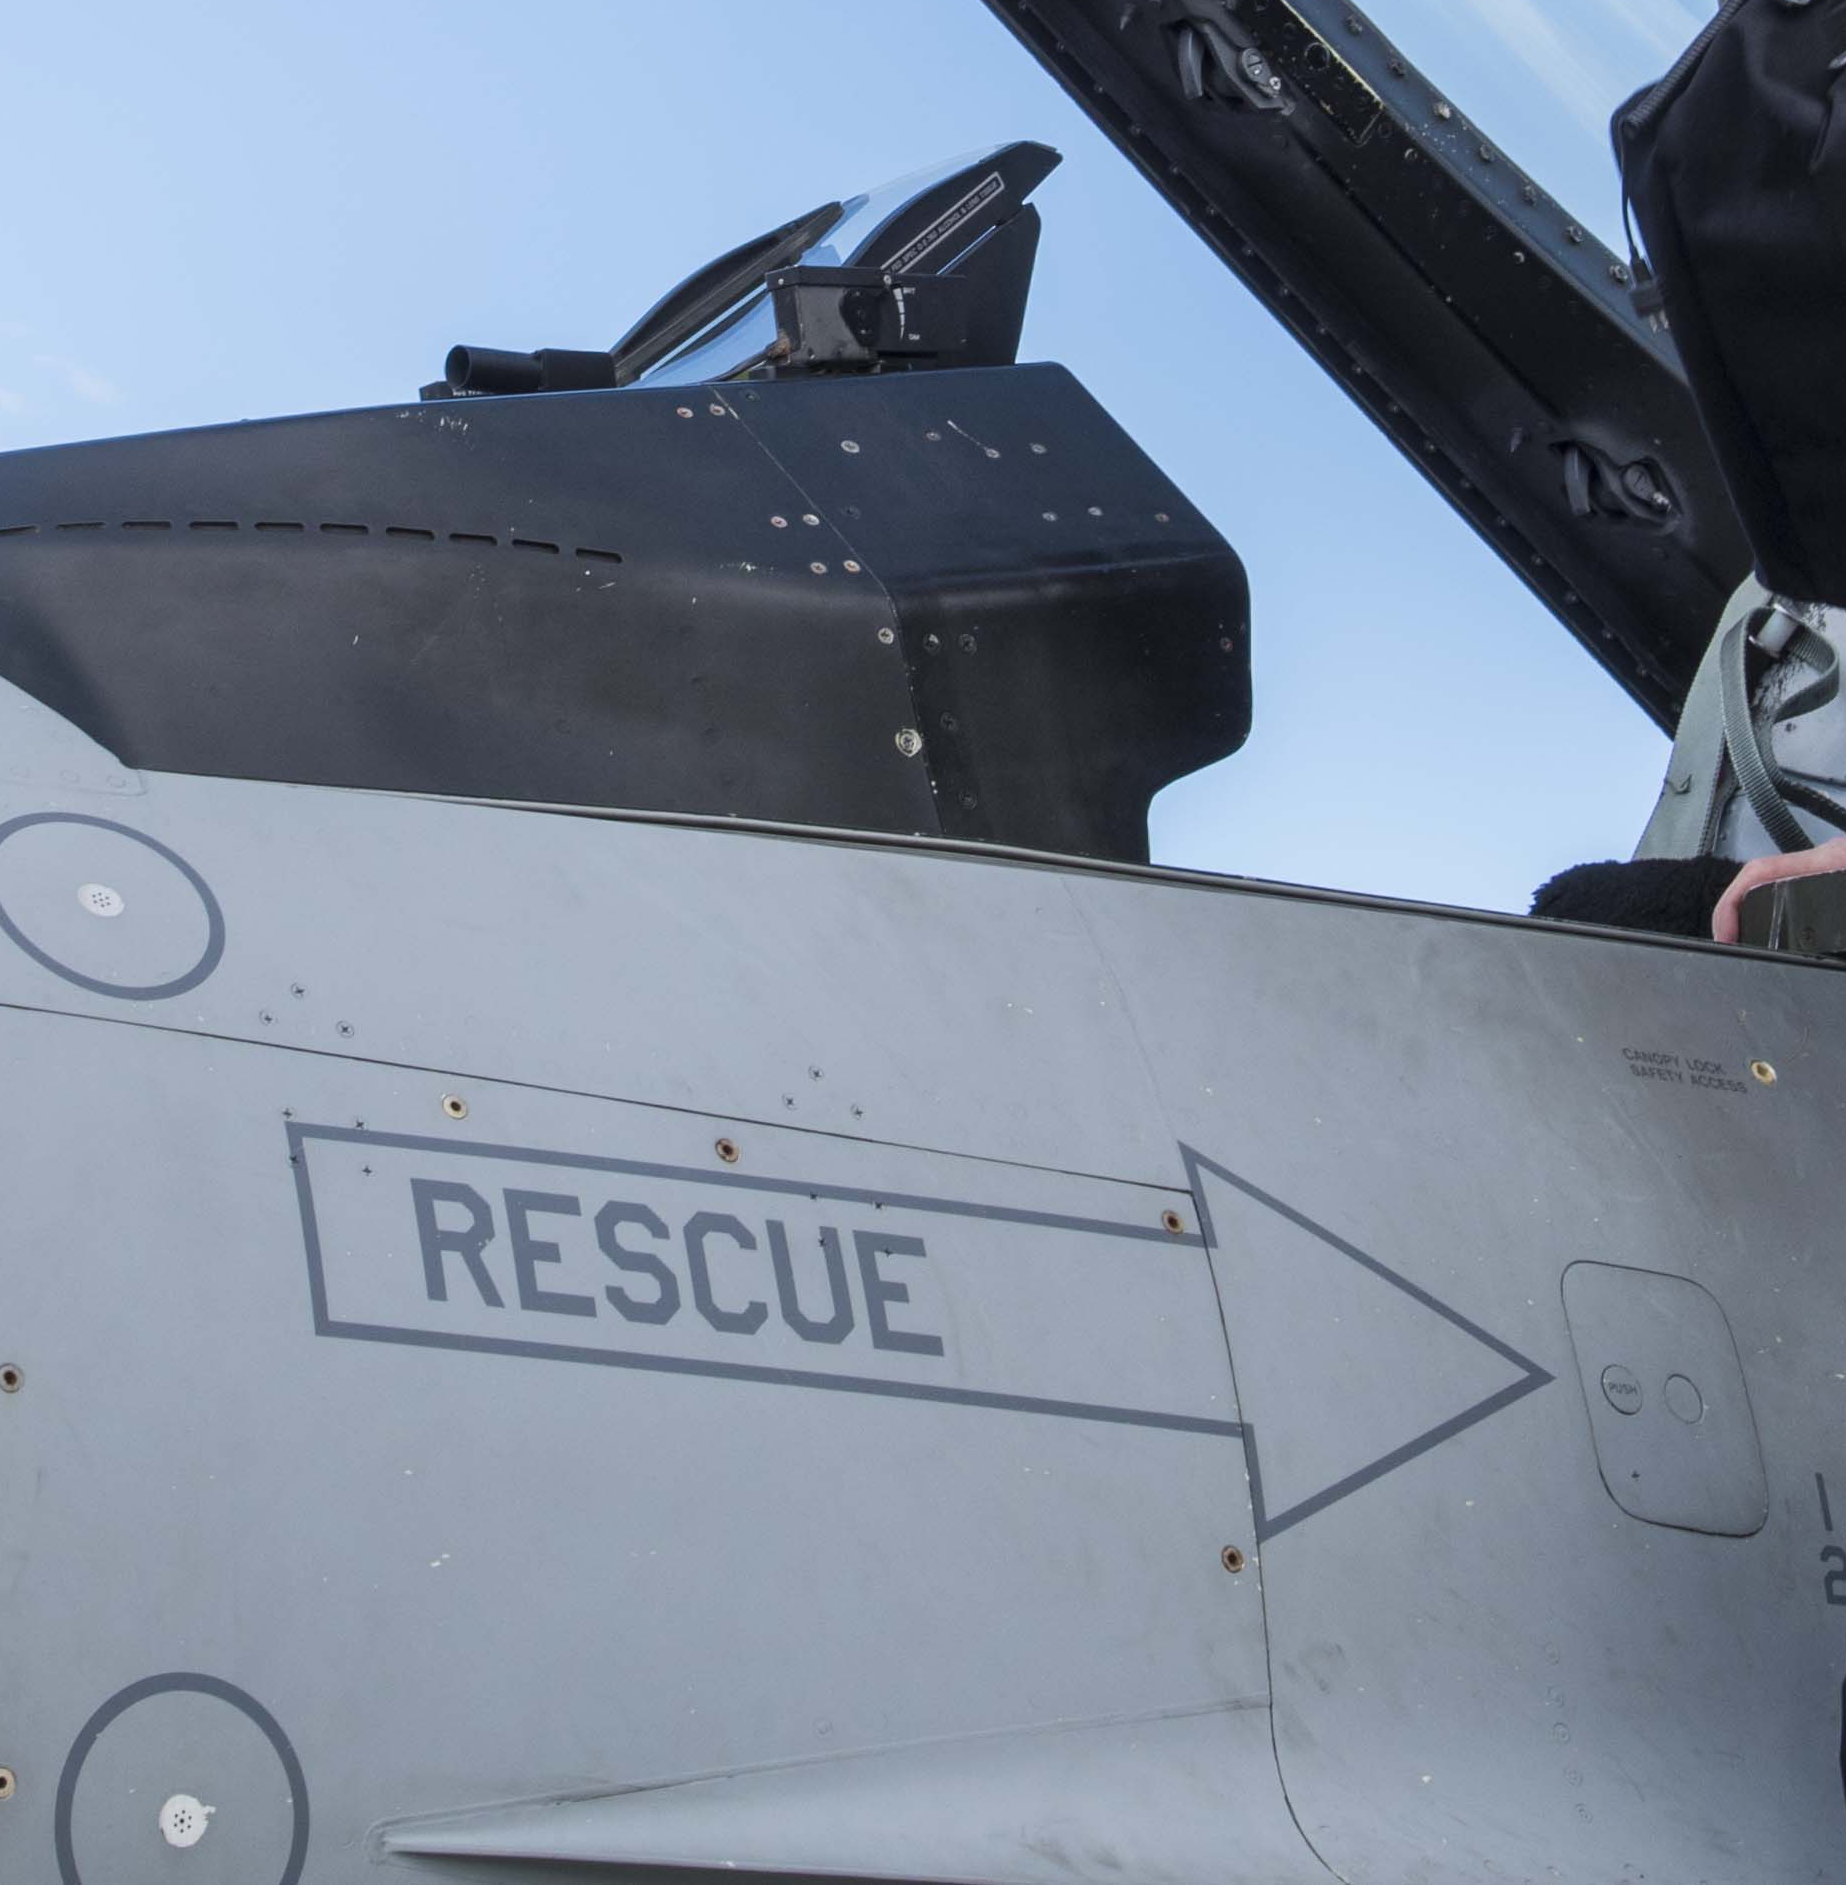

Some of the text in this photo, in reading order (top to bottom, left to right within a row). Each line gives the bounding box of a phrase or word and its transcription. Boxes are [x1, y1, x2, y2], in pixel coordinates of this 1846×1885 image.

[1622, 1047, 1728, 1076] CANOPY LOCK
[1629, 1064, 1748, 1094] SAFETY ACCESS
[410, 1177, 944, 1357] RESCUE
[1608, 1381, 1639, 1395] PUSH
